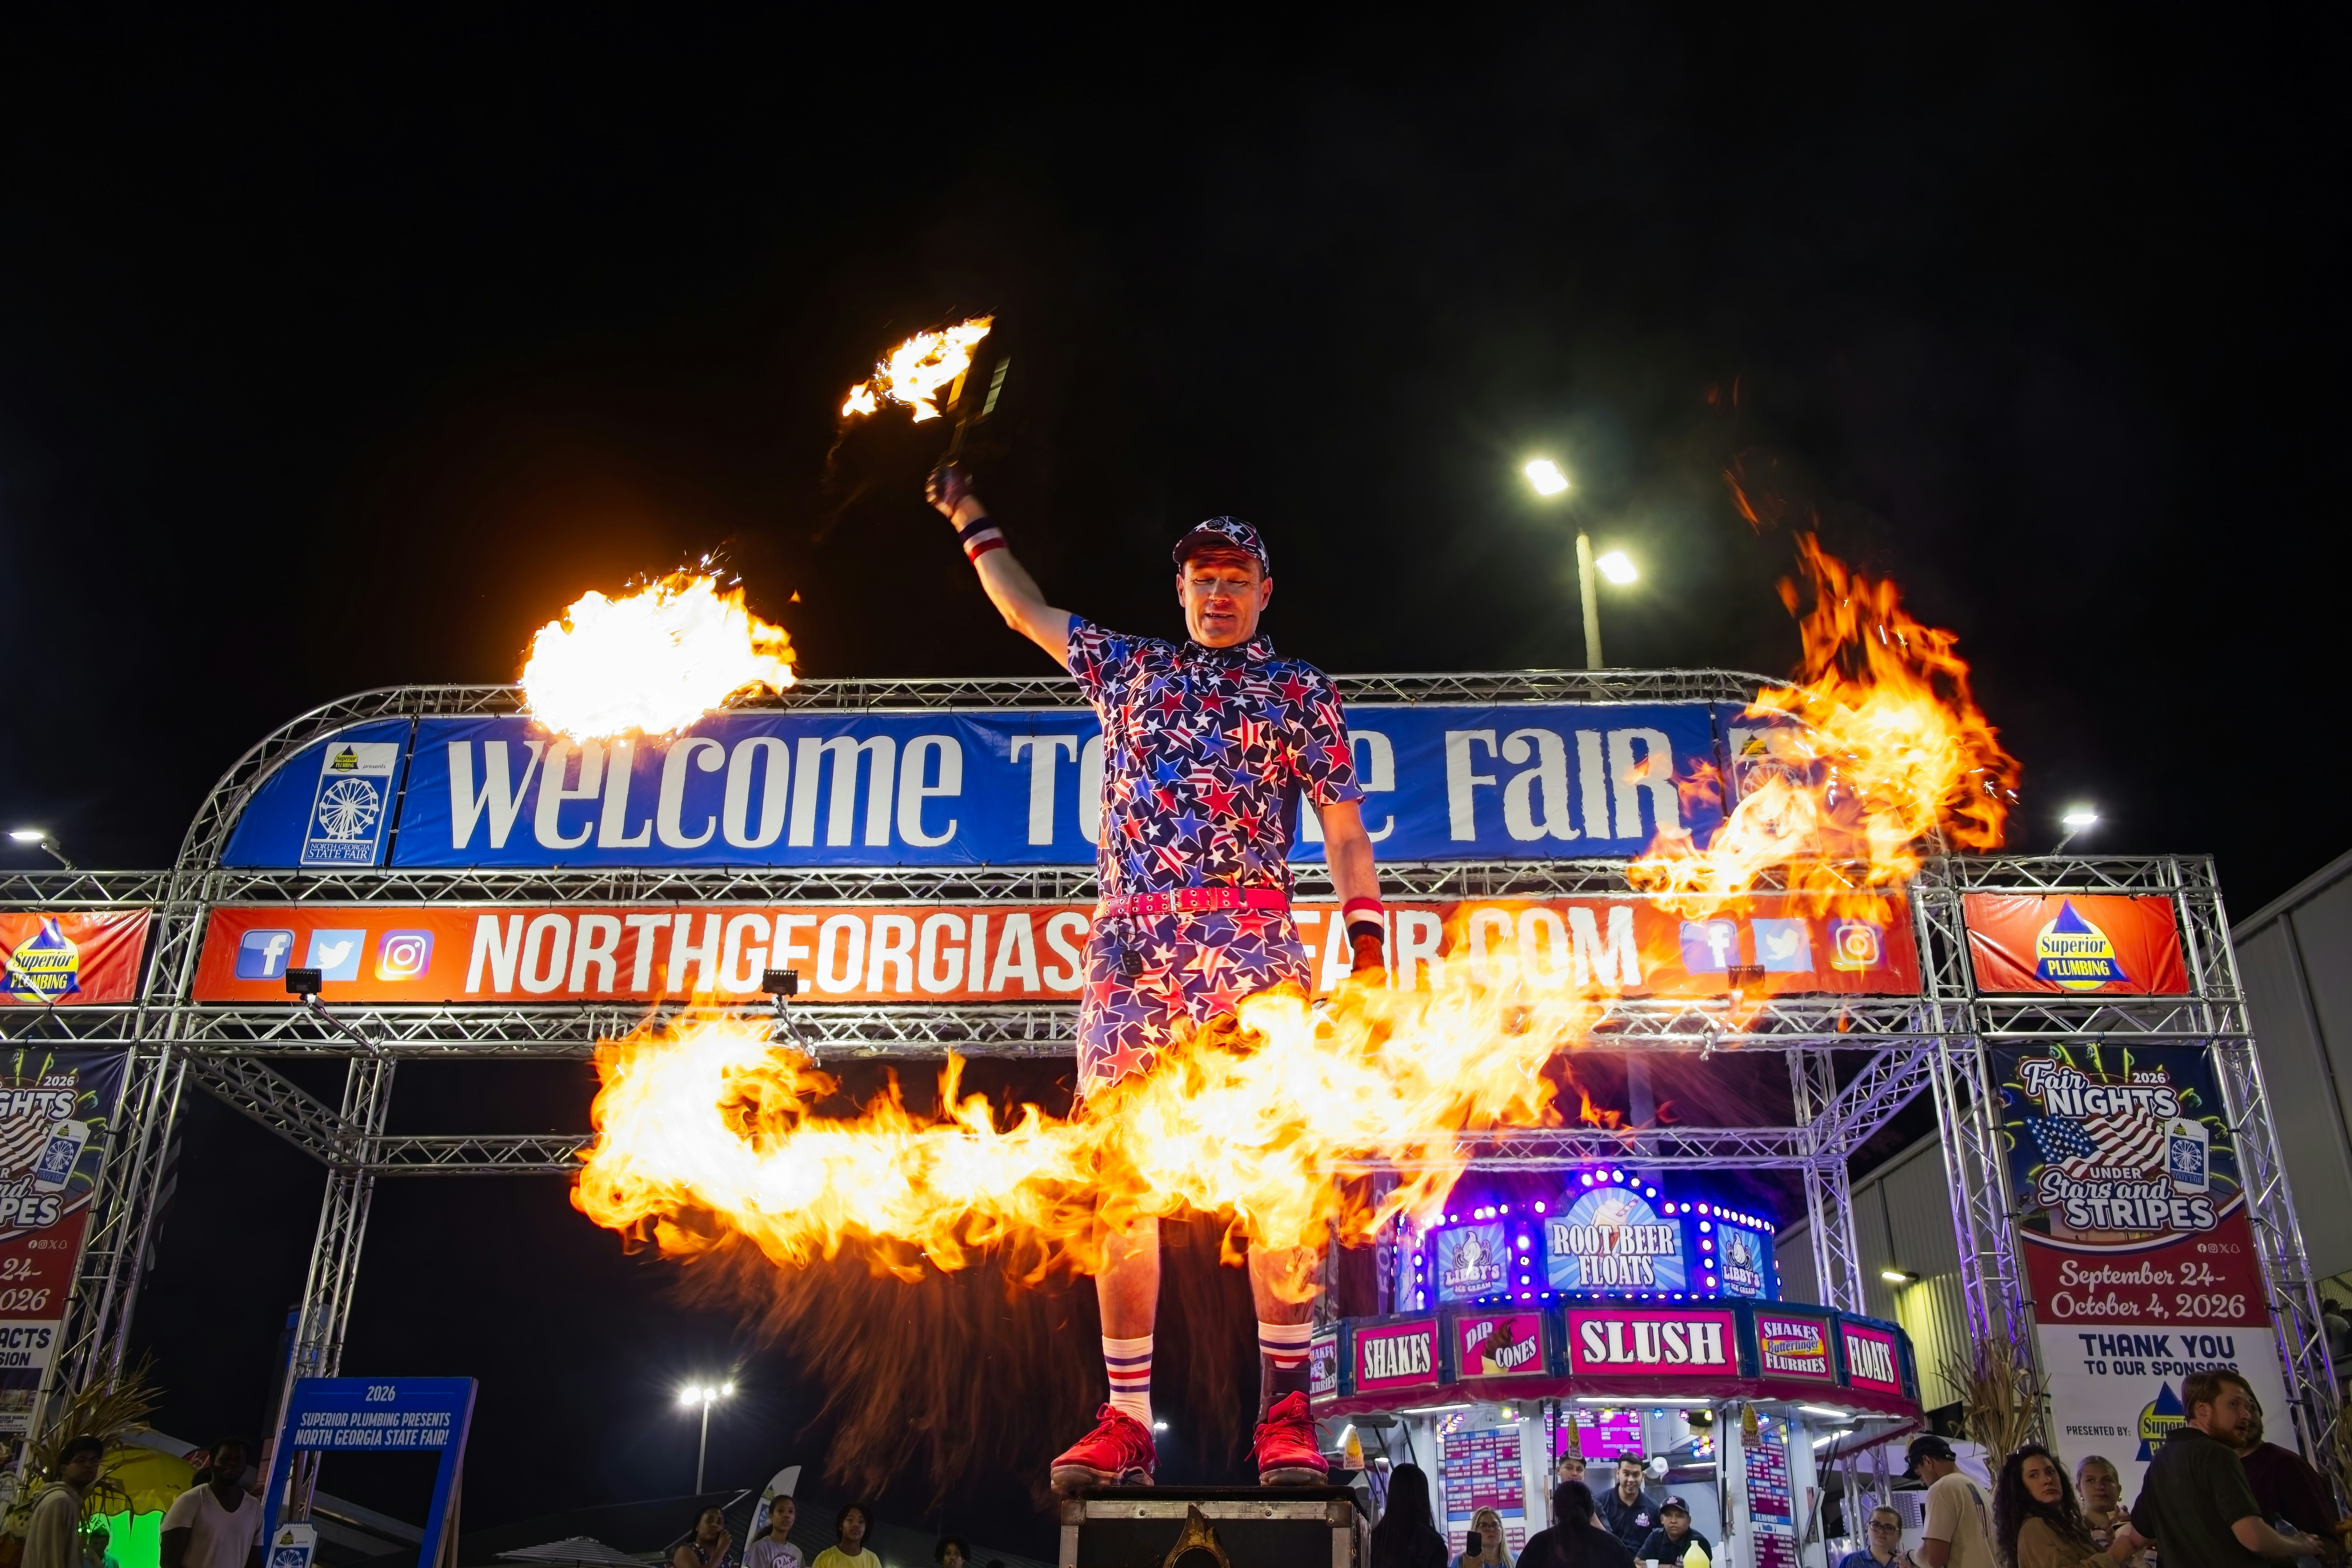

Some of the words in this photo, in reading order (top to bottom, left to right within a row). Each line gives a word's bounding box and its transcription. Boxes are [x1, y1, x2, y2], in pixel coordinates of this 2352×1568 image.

[308, 849, 341, 858] STATE
[343, 850, 368, 859] FAIR
[2042, 936, 2106, 956] Superior
[13, 952, 74, 971] Superior
[2047, 960, 2110, 976] PLUMBING
[43, 1076, 75, 1086] 2026
[2024, 1062, 2085, 1094] Fair
[2132, 1073, 2166, 1083] 2026
[2046, 1088, 2177, 1117] NIGHTS
[2090, 1167, 2142, 1179] UNDER
[2040, 1172, 2111, 1203] Stars
[2116, 1177, 2170, 1200] and
[2069, 1198, 2212, 1227] STRIPES
[1552, 1223, 1613, 1255] ROOT
[1617, 1224, 1675, 1254] BEER
[0, 1258, 42, 1281] 24-
[1445, 1265, 1500, 1285] LIBBY'S
[1578, 1255, 1655, 1285] FLOATS
[1723, 1266, 1760, 1288] LIBBY'S
[2059, 1259, 2175, 1293] September
[2180, 1262, 2226, 1287] 24-
[1455, 1285, 1466, 1293] ICE
[1467, 1281, 1491, 1292] CREAM
[1731, 1283, 1739, 1292] ICE
[1740, 1286, 1755, 1295] CREAM
[2051, 1291, 2140, 1318] October
[2146, 1293, 2169, 1319] 4,
[2176, 1294, 2245, 1318] 2026
[1465, 1321, 1494, 1354] DIP
[1764, 1321, 1820, 1341] SHAKES
[1310, 1345, 1334, 1360] HAKES
[1495, 1335, 1536, 1368] CONES
[1581, 1321, 1726, 1364] SLUSH
[1767, 1338, 1819, 1353] Butterfinger
[2078, 1334, 2174, 1357] THANK
[2180, 1335, 2235, 1359] YOU
[1365, 1332, 1431, 1380] SHAKES
[1764, 1351, 1826, 1373] FLURRIES
[1846, 1335, 1894, 1383] FLOATS
[2084, 1360, 2107, 1375] TO
[2112, 1360, 2147, 1376] OUR
[365, 1386, 396, 1401] 2026
[1310, 1373, 1335, 1394] URRIES
[300, 1413, 348, 1427] SUPERIOR
[350, 1413, 400, 1427] PLUMBING
[401, 1413, 451, 1427] PRESENTS
[2143, 1417, 2187, 1437] Superi
[294, 1430, 333, 1445] NORTH
[334, 1430, 382, 1446] GEORGIA
[384, 1430, 419, 1445] STATE
[419, 1430, 450, 1445] FAIR!
[2066, 1426, 2114, 1436] PRESENTED
[2117, 1426, 2131, 1436] BY:
[1755, 1513, 1778, 1523] FLAVORS
